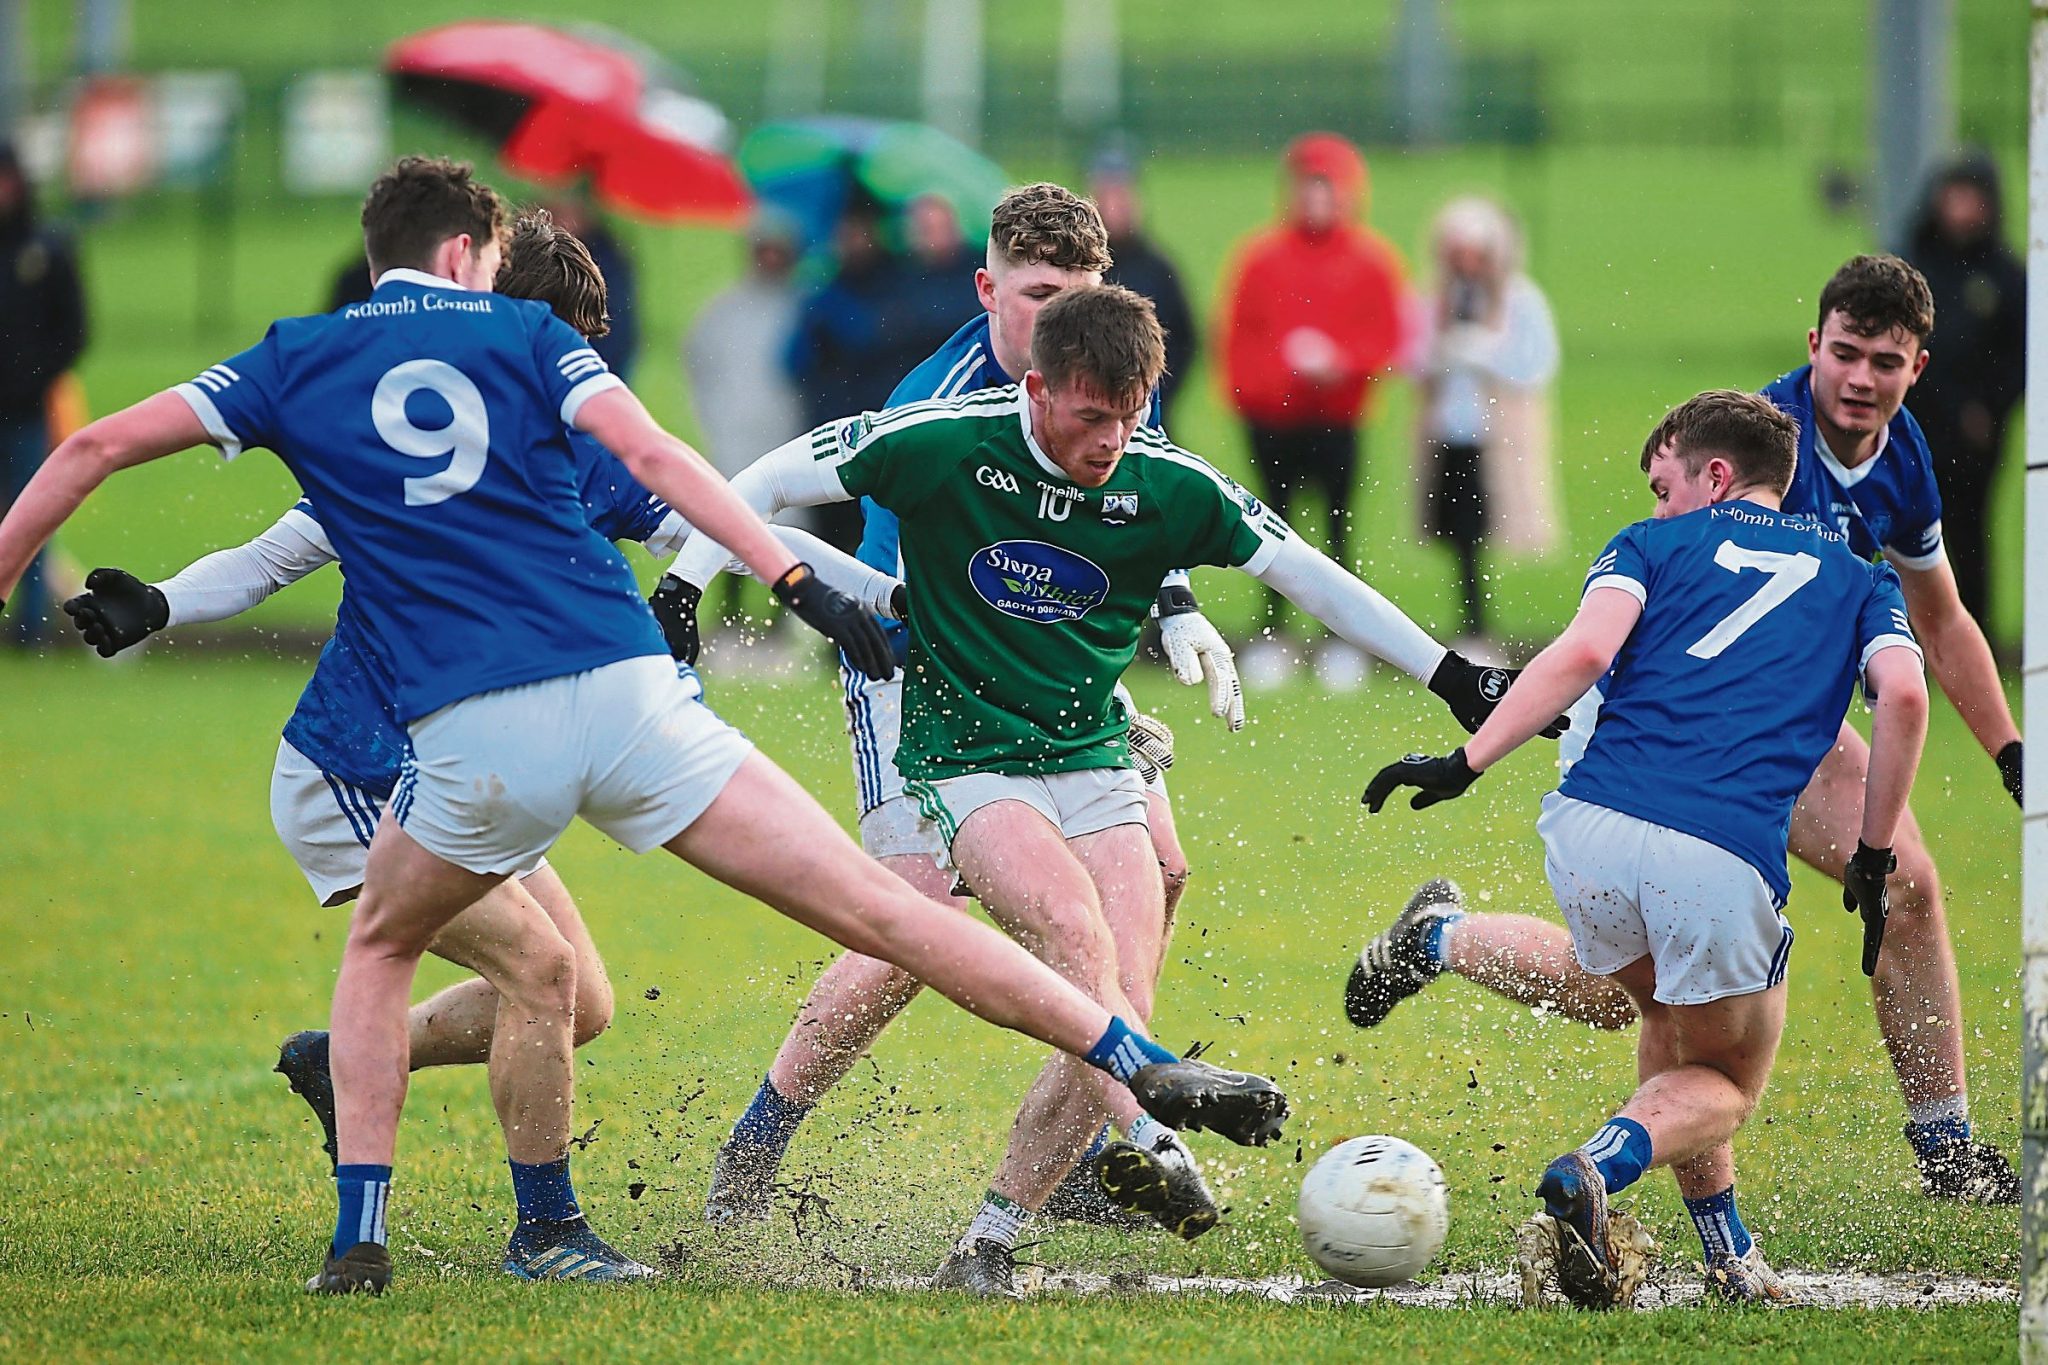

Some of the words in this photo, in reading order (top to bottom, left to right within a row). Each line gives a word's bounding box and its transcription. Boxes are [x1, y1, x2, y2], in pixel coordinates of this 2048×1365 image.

[371, 358, 490, 507] 9
[975, 465, 1021, 494] GAA
[1037, 488, 1073, 522] 10
[996, 599, 1035, 614] GAOTH
[1685, 539, 1822, 660] 7
